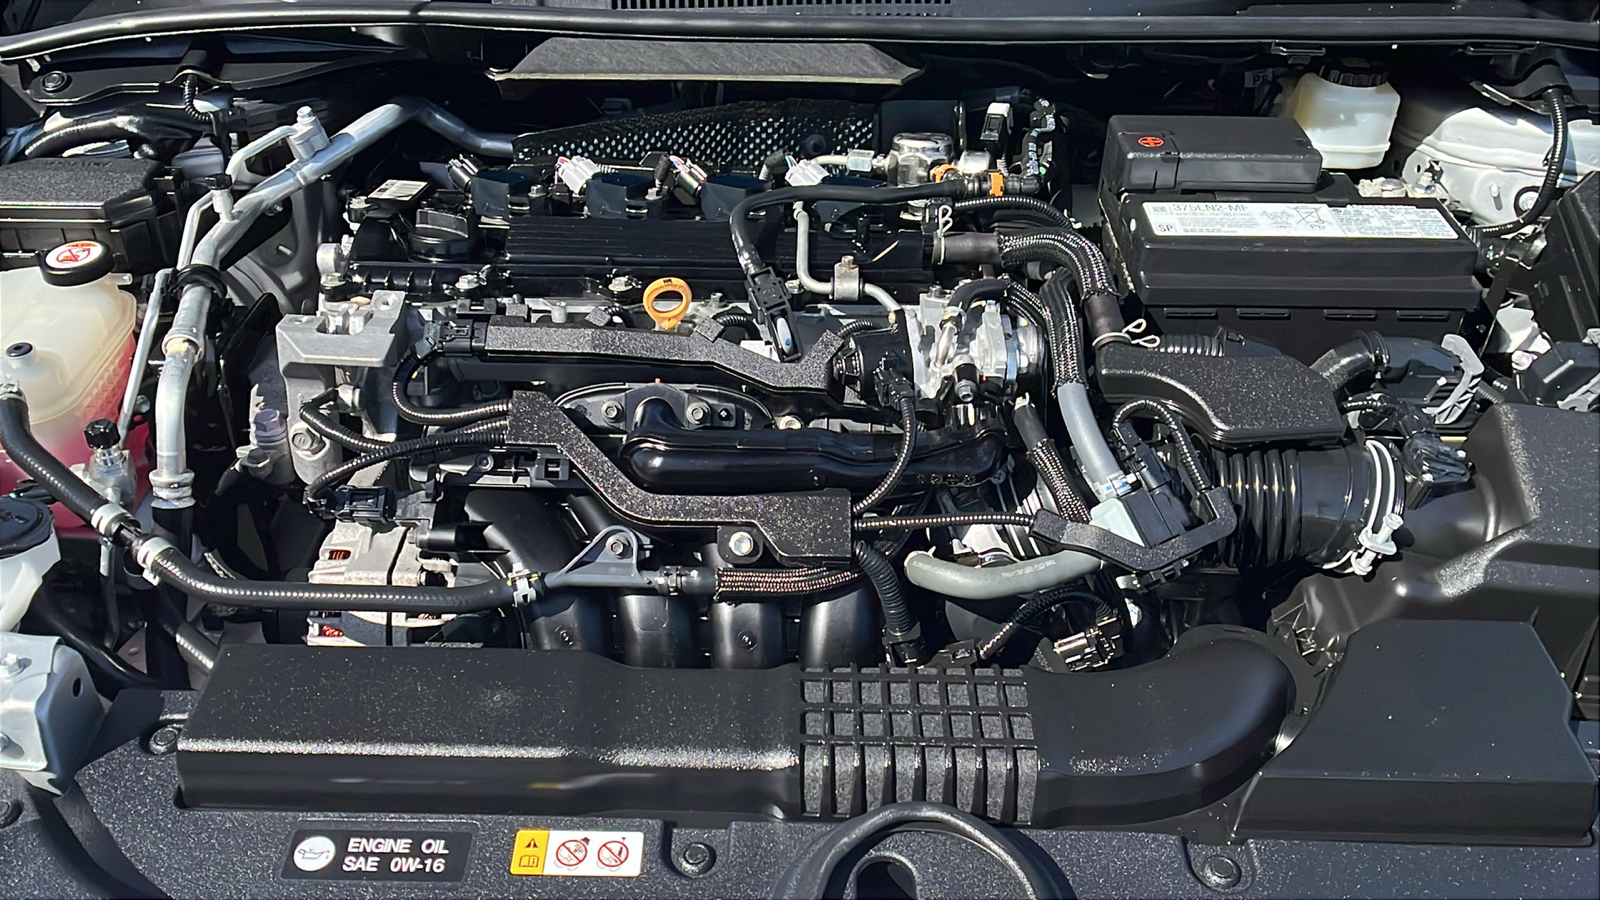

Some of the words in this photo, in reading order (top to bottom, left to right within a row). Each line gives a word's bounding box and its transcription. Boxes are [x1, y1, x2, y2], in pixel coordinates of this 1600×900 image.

[1172, 203, 1250, 212] 375LN2-MF
[1157, 224, 1173, 233] SP
[347, 837, 413, 853] ENGINE
[421, 838, 450, 854] OIL
[342, 856, 381, 872] SAE
[389, 857, 446, 873] 0W-16
